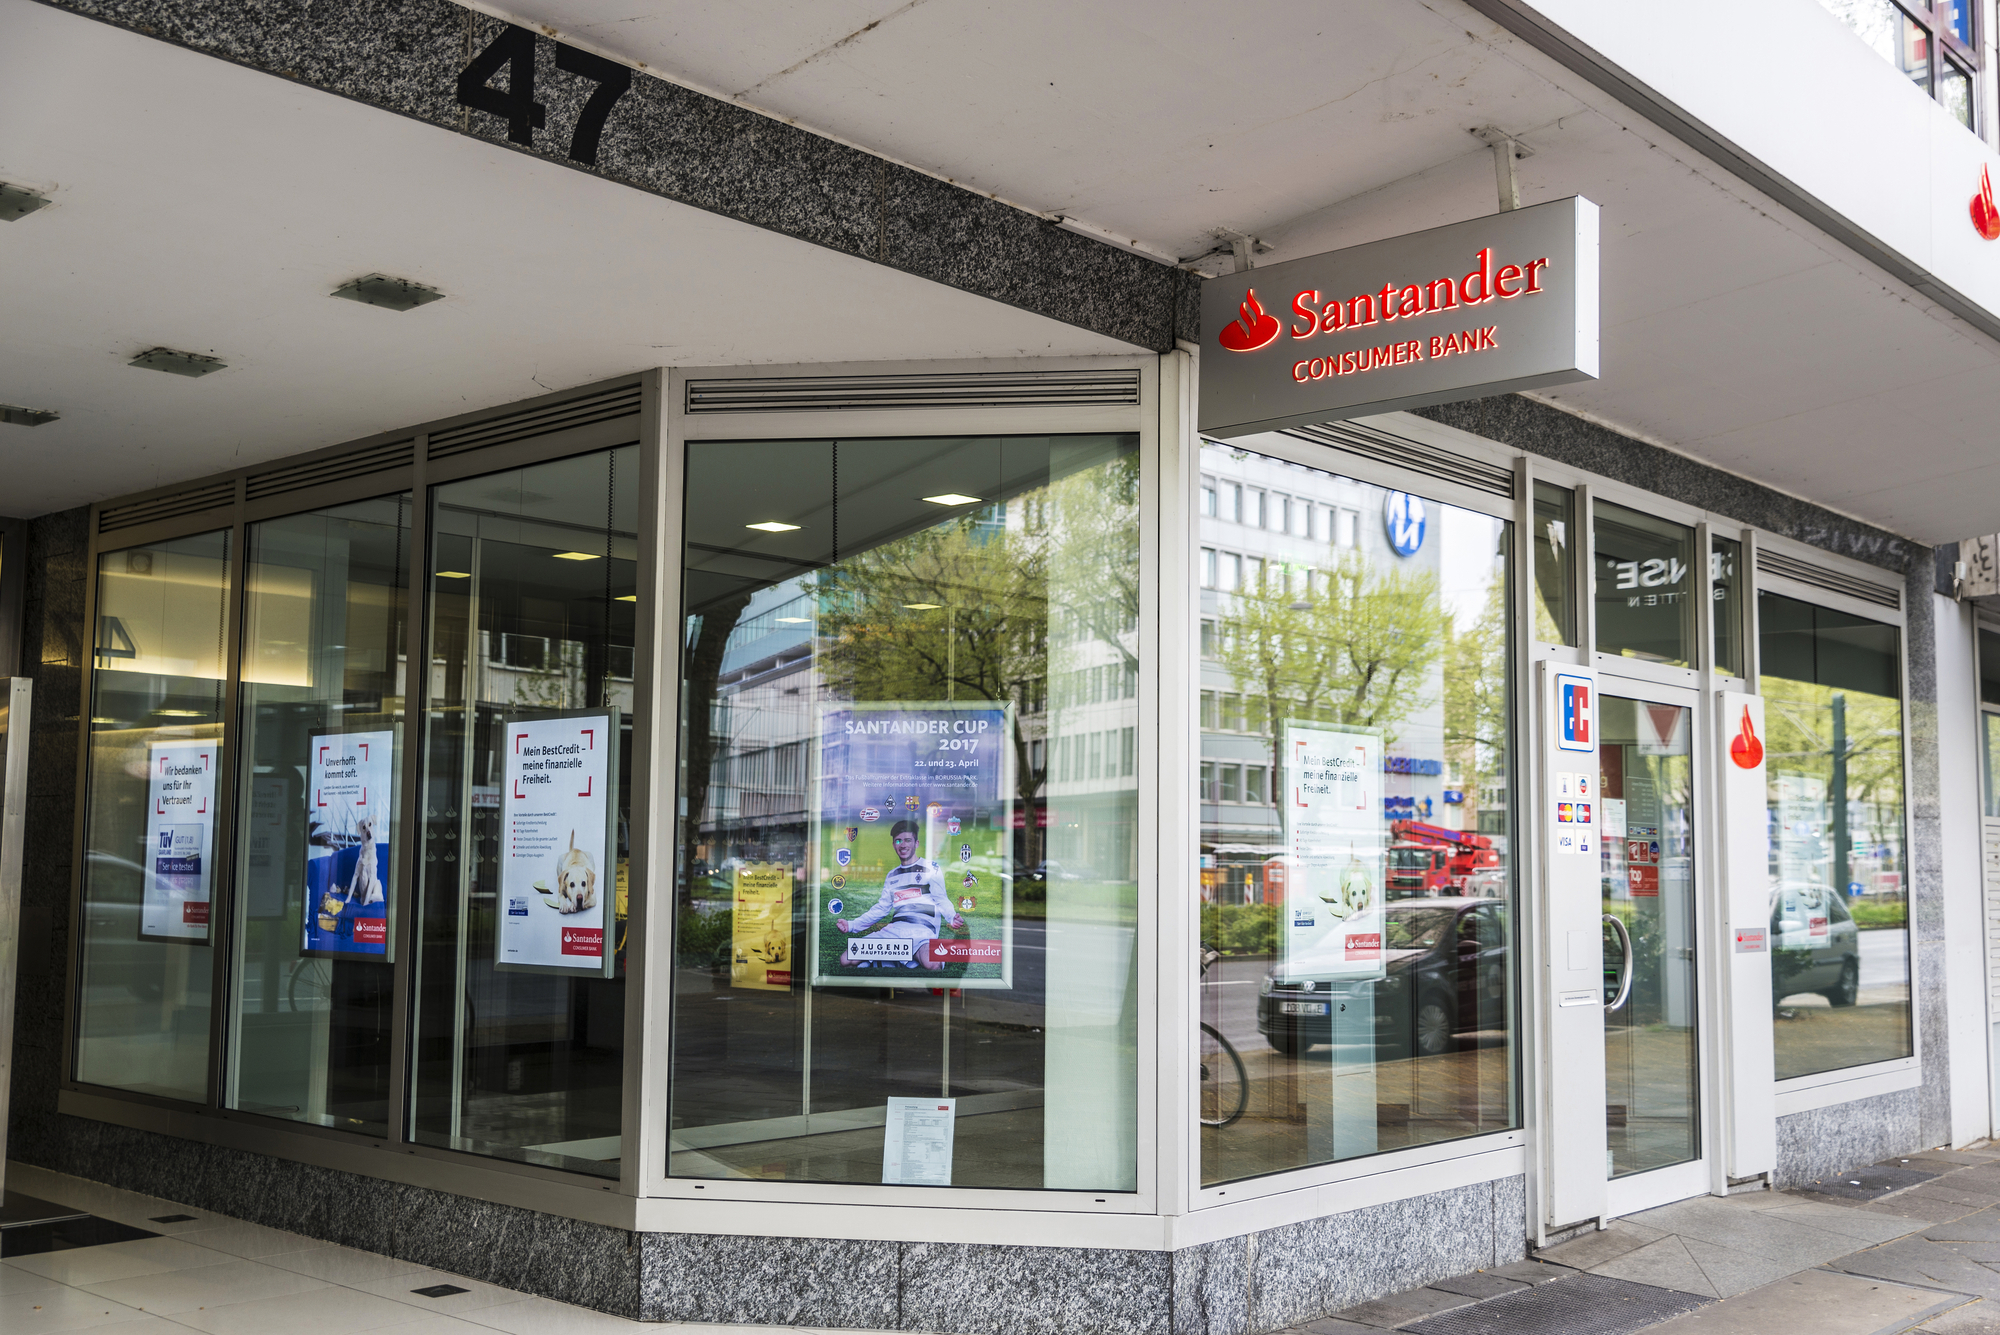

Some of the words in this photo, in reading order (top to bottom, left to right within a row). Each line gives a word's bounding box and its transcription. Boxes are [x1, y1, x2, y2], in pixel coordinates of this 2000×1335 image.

[457, 23, 632, 166] 47
[1290, 247, 1550, 339] Santander
[1293, 339, 1423, 383] CONSUMER
[1430, 325, 1498, 359] BANK
[845, 721, 949, 734] SANTANDER
[953, 720, 988, 734] CUP
[523, 746, 540, 757] Mein
[542, 744, 579, 756] BestCredit
[939, 739, 979, 754] 2017
[325, 755, 356, 766] Unverhofft
[523, 760, 543, 770] meine
[545, 758, 582, 770] finanzielle
[959, 759, 979, 768] April
[1303, 755, 1320, 766] Mein
[1322, 757, 1355, 768] BestCredit
[165, 766, 174, 776] Wir
[174, 765, 202, 775] bedanken
[325, 770, 344, 778] kommt
[345, 768, 357, 778] soft.
[1303, 771, 1324, 780] meine
[1325, 770, 1358, 782] finanzielle
[522, 774, 552, 784] Freiheit.
[173, 780, 182, 790] für
[1303, 784, 1331, 794] Freiheit.
[162, 795, 192, 805] Vertrauen!
[1559, 836, 1572, 846] VISA
[573, 933, 603, 943] Santander
[1355, 938, 1379, 948] Santander
[950, 945, 1001, 956] Santander
